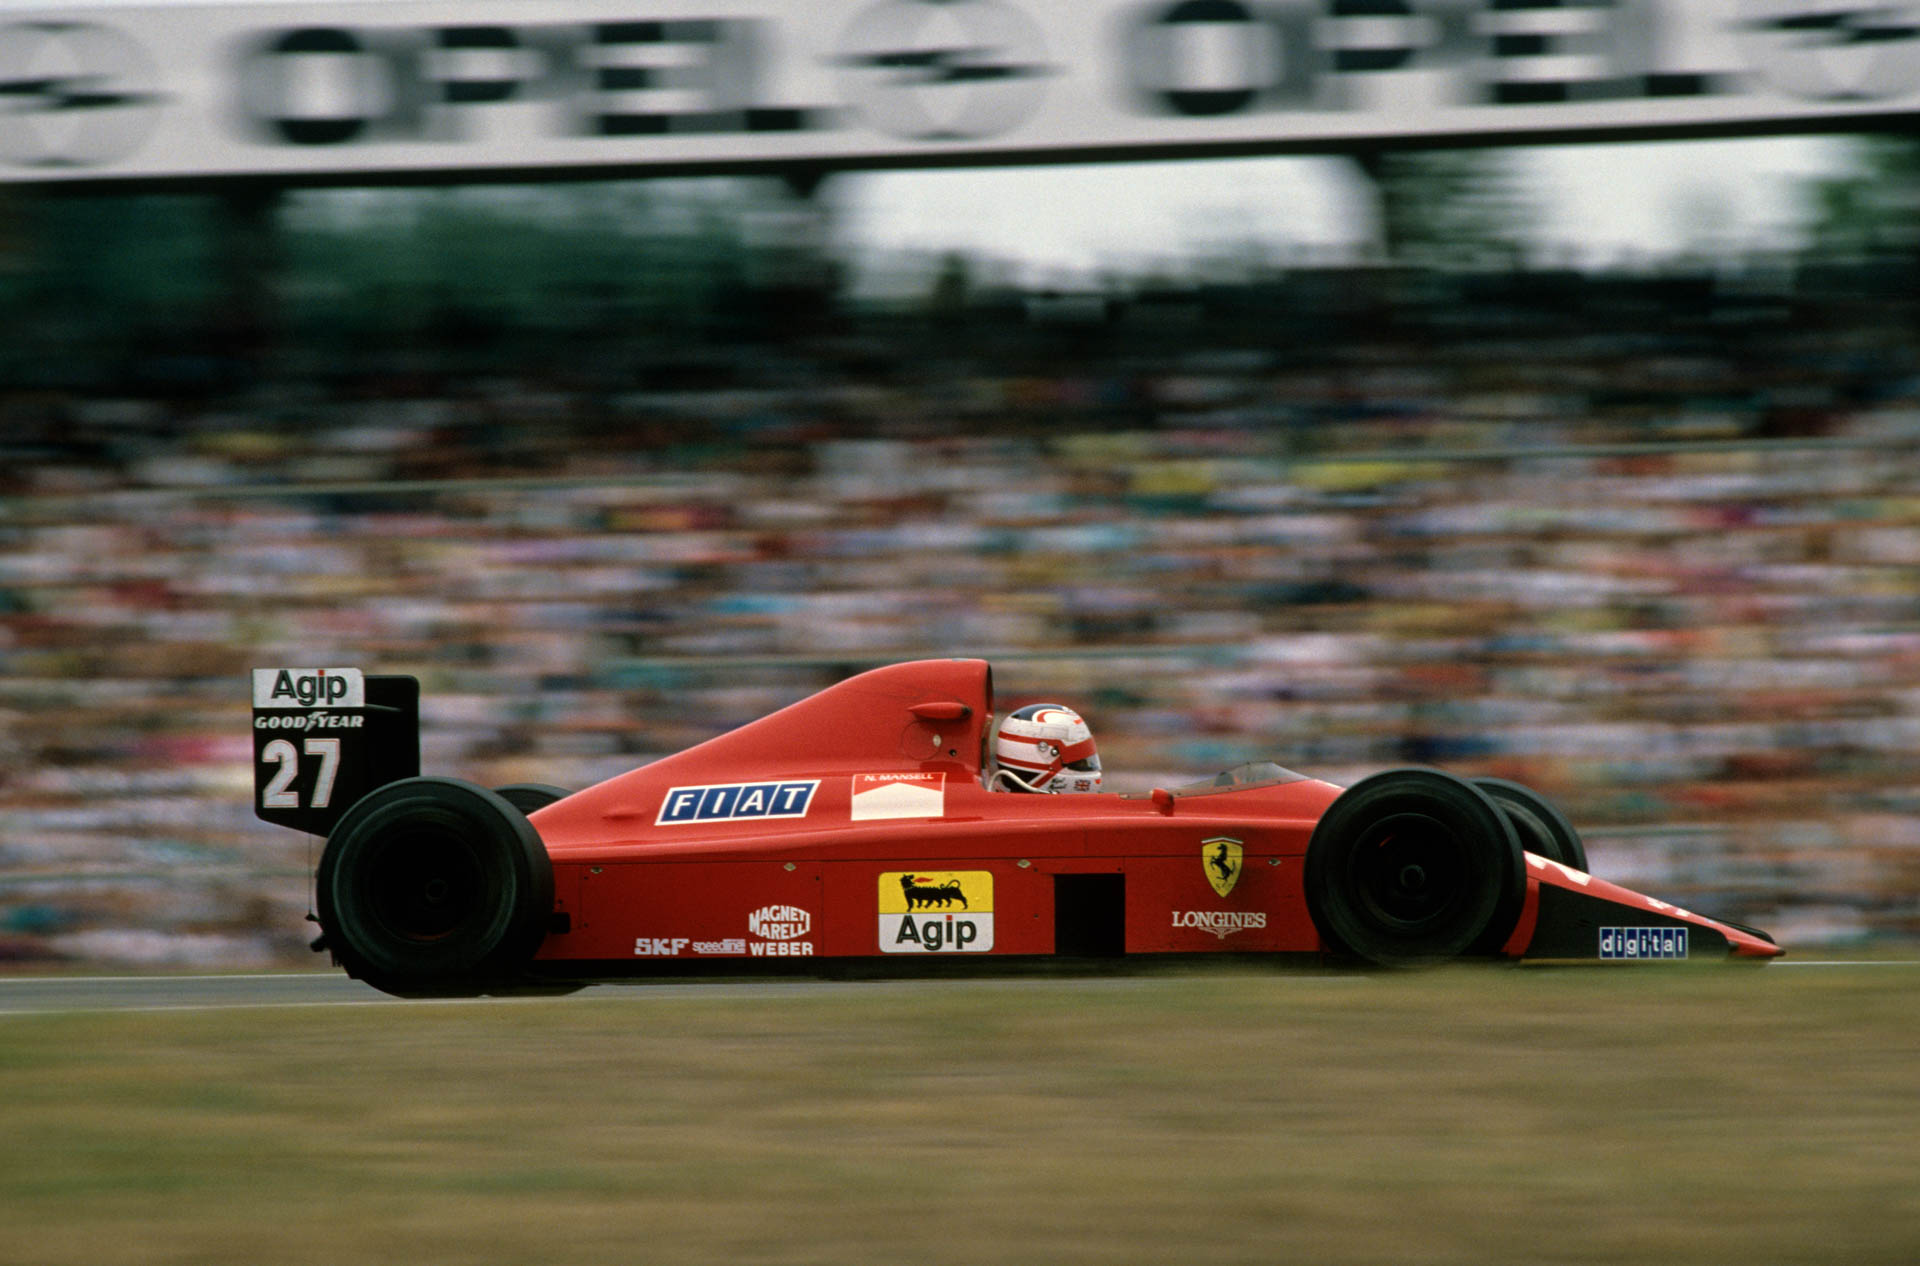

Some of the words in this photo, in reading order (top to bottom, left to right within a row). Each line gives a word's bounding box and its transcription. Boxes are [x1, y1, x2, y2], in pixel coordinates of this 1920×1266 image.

[1120, 0, 1745, 115] OPEL
[232, 17, 838, 145] OPEL
[271, 670, 347, 706] Agip
[262, 738, 341, 808] 27
[879, 772, 934, 780] MANSELL
[671, 786, 806, 816] FIAT
[896, 915, 977, 951] Agip
[1172, 911, 1267, 928] LONGINES
[634, 938, 689, 955] SKF
[750, 942, 813, 956] WEBER
[1602, 935, 1683, 955] digital
